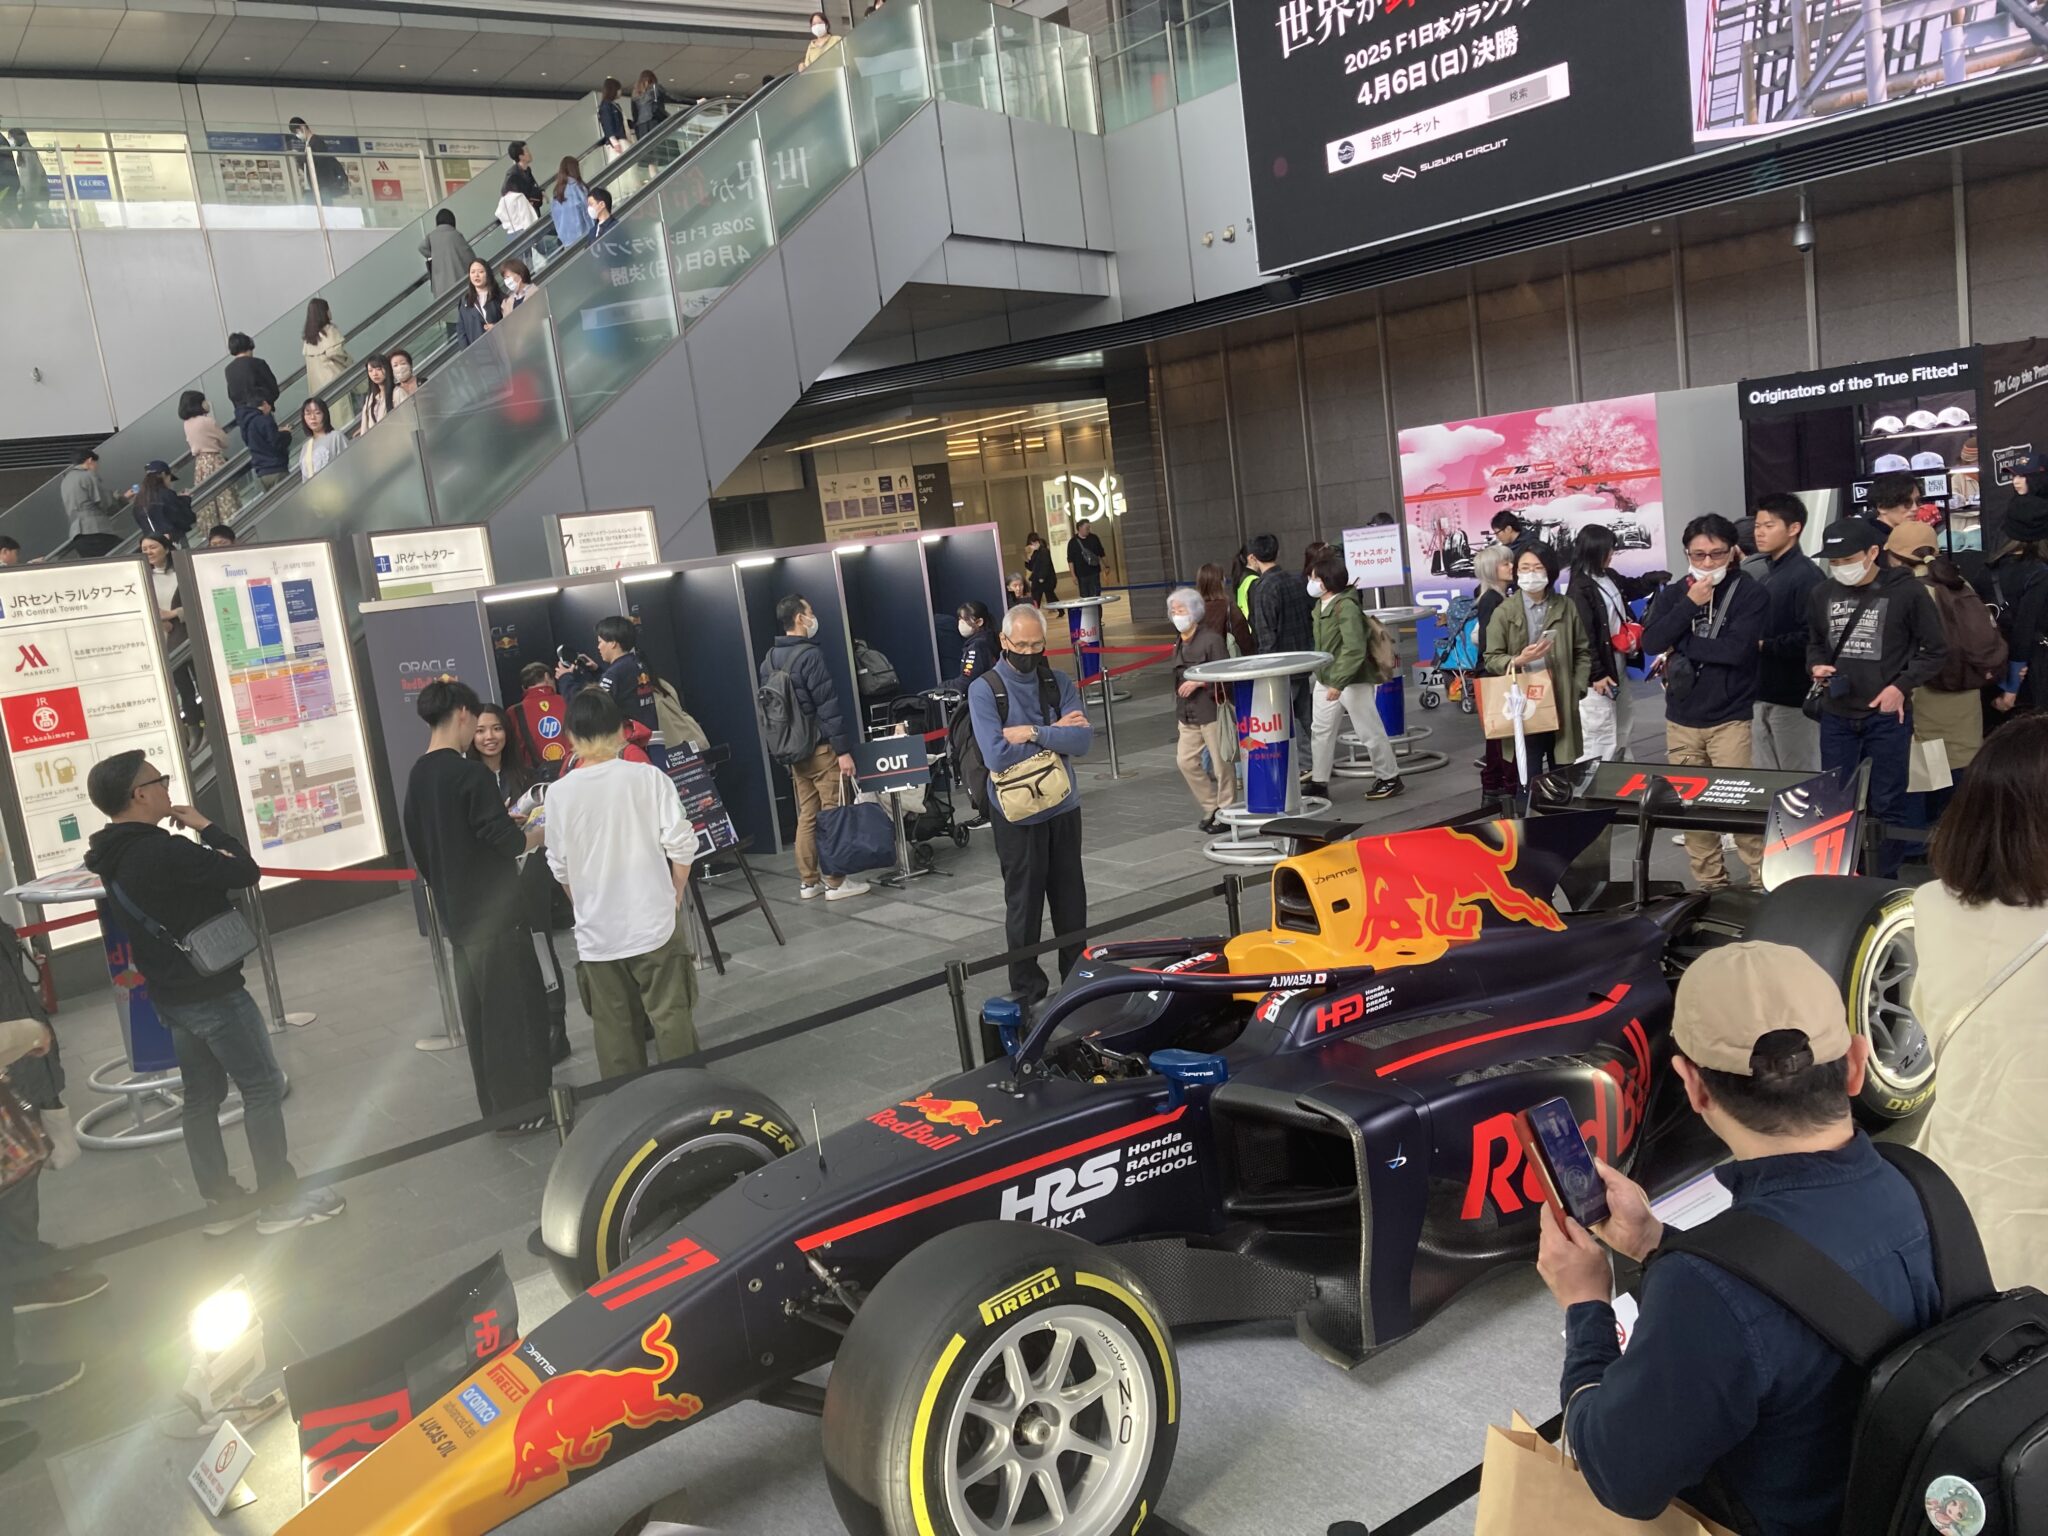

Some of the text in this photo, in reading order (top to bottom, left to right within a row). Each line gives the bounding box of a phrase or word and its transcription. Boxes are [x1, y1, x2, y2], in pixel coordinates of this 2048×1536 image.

[1344, 40, 1392, 74] 2025
[1509, 87, 1529, 103] 検索
[1370, 116, 1440, 150] 鈴鹿サーキット
[1420, 138, 1508, 172] SUZUKA CIRCUIT
[1748, 383, 1826, 406] Originators
[1829, 380, 1846, 394] of
[1848, 376, 1873, 393] the
[1874, 370, 1909, 390] True
[1497, 480, 1550, 494] JAPANESE
[1493, 488, 1555, 503] GRAND PRIX
[394, 549, 455, 564] JRゲートタワー
[1350, 547, 1396, 558] フォトスポット
[395, 562, 438, 573] JR Gate Tower
[1354, 556, 1393, 566] Photo spot
[10, 583, 137, 609] JRセントラルタワーズ
[11, 603, 89, 619] JR Central Towers
[23, 667, 61, 678] MARRIOTT
[399, 658, 457, 673] ORACLE
[36, 697, 48, 707] JR
[543, 717, 557, 734] hp
[23, 731, 76, 745] Takashimaya
[671, 755, 698, 767] CHALLENGE
[876, 754, 909, 772] OUT
[1709, 785, 1765, 794] FORMULA
[1714, 778, 1751, 787] Honda
[1697, 796, 1750, 805] PROJECT
[1703, 791, 1746, 799] DREAM
[1813, 828, 1846, 876] 11
[1269, 973, 1313, 989] A.IWASA
[1365, 984, 1384, 995] Honda
[1365, 986, 1395, 1002] FORMULA
[1365, 995, 1388, 1008] DREAM
[1365, 1000, 1393, 1015] PROJECT
[709, 1109, 796, 1153] P ZER
[1128, 1132, 1182, 1158] Honda
[1126, 1141, 1193, 1172] RACING
[1124, 1155, 1197, 1187] SCHOOL
[1000, 1149, 1121, 1223] HRS
[586, 1237, 720, 1311] 11
[978, 1266, 1061, 1327] PIRELLI
[1097, 1329, 1128, 1372] RACING
[523, 1342, 559, 1377] DAMS
[486, 1362, 530, 1404] PIRELLI
[462, 1387, 497, 1424] aramco
[442, 1401, 480, 1439] advanced fuel
[419, 1416, 457, 1458] LUCAS OIL
